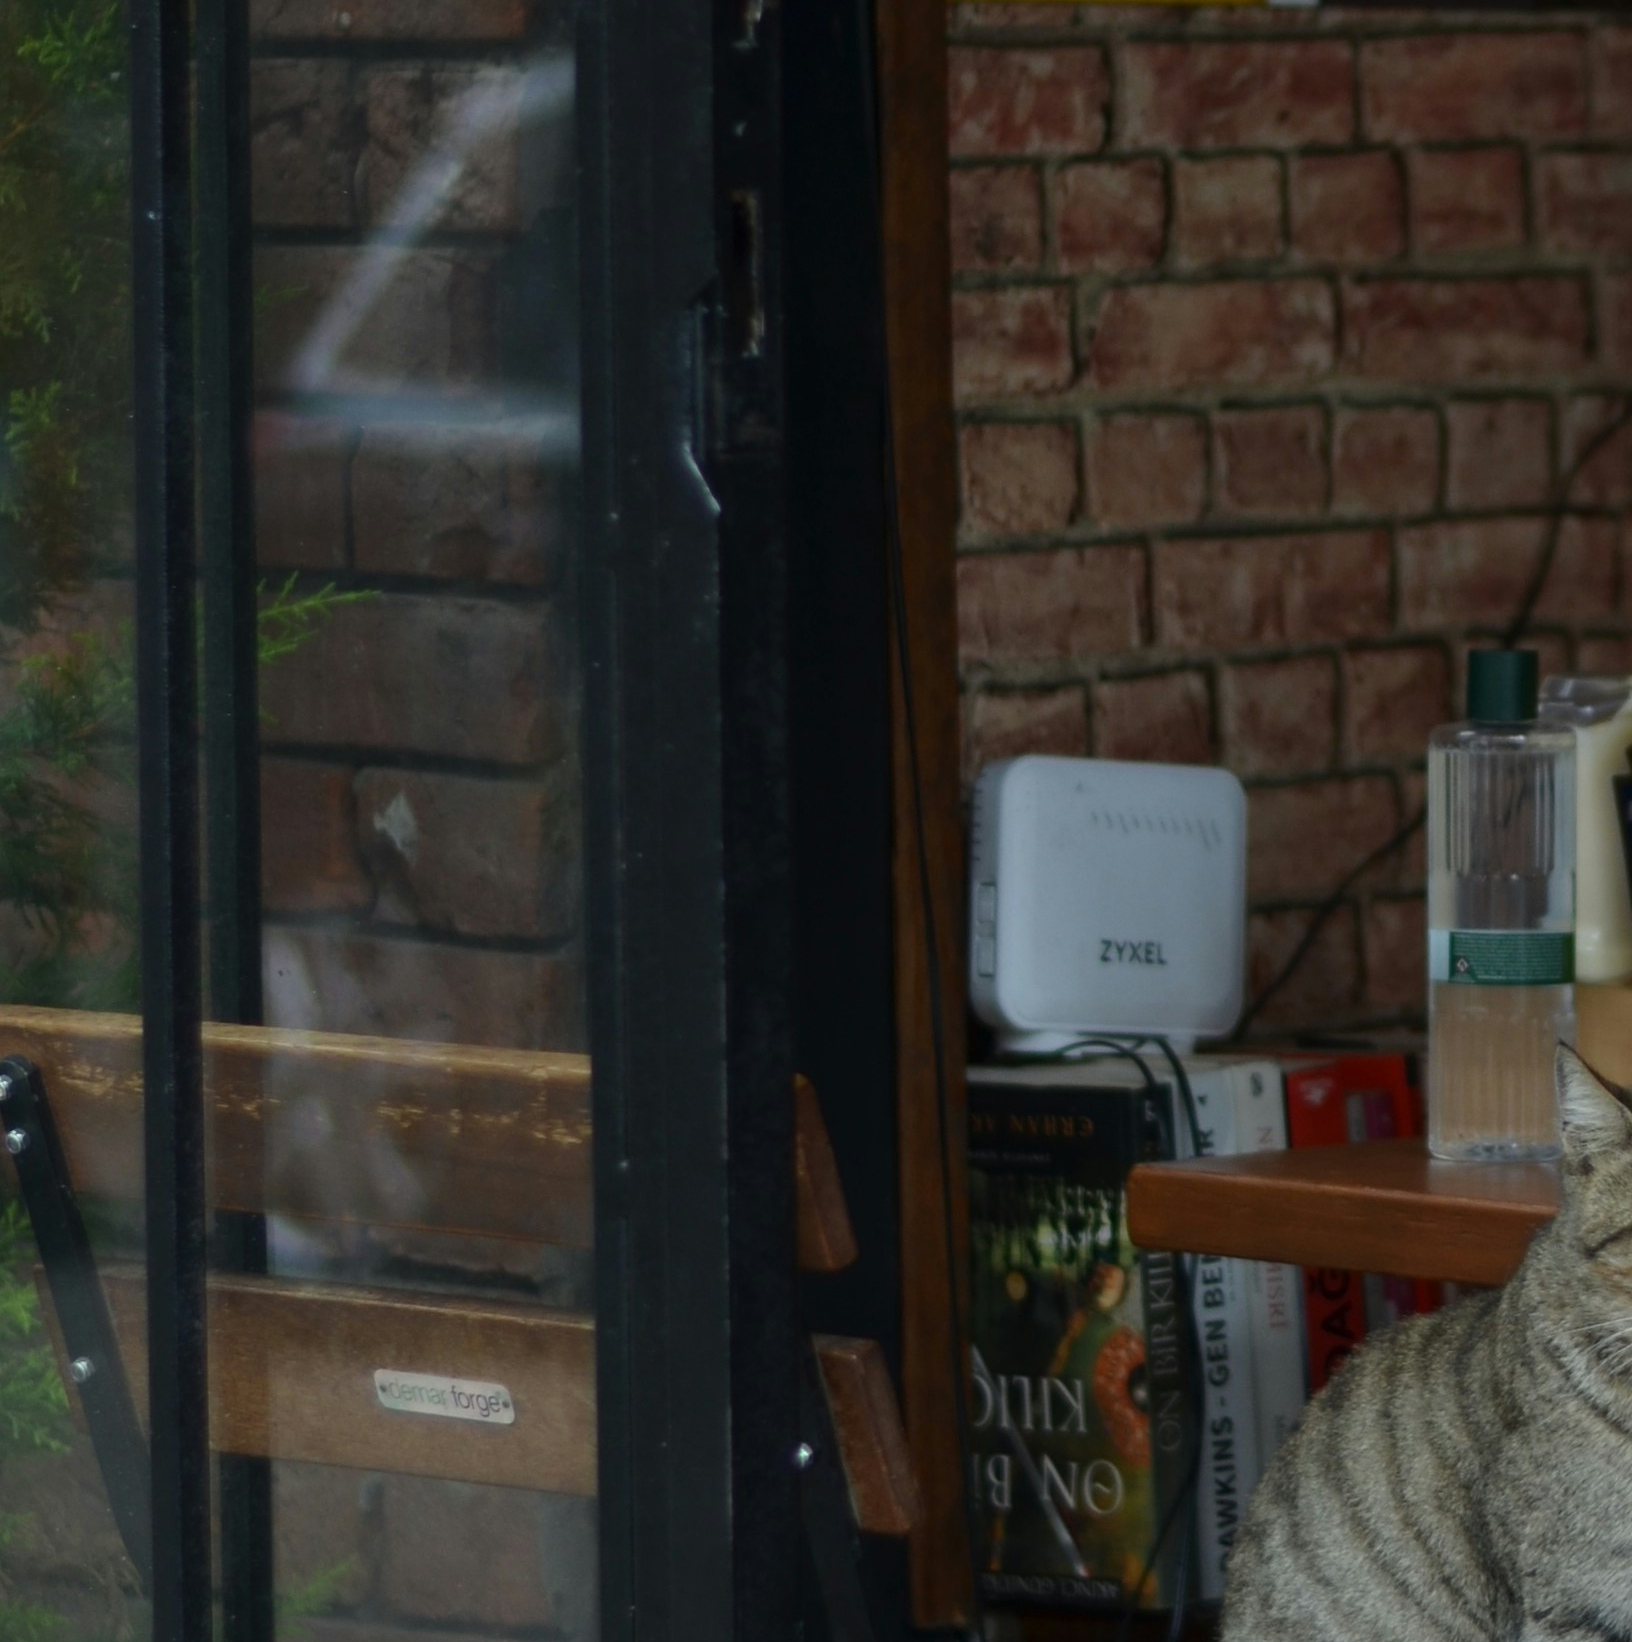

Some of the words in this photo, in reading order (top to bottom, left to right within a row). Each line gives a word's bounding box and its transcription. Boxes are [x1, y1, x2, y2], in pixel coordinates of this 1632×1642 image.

[1100, 938, 1168, 966] ZYXEL
[1203, 1319, 1231, 1386] GEN
[450, 1384, 502, 1418] forge
[1157, 1389, 1183, 1452] ON
[1038, 1452, 1125, 1515] ON
